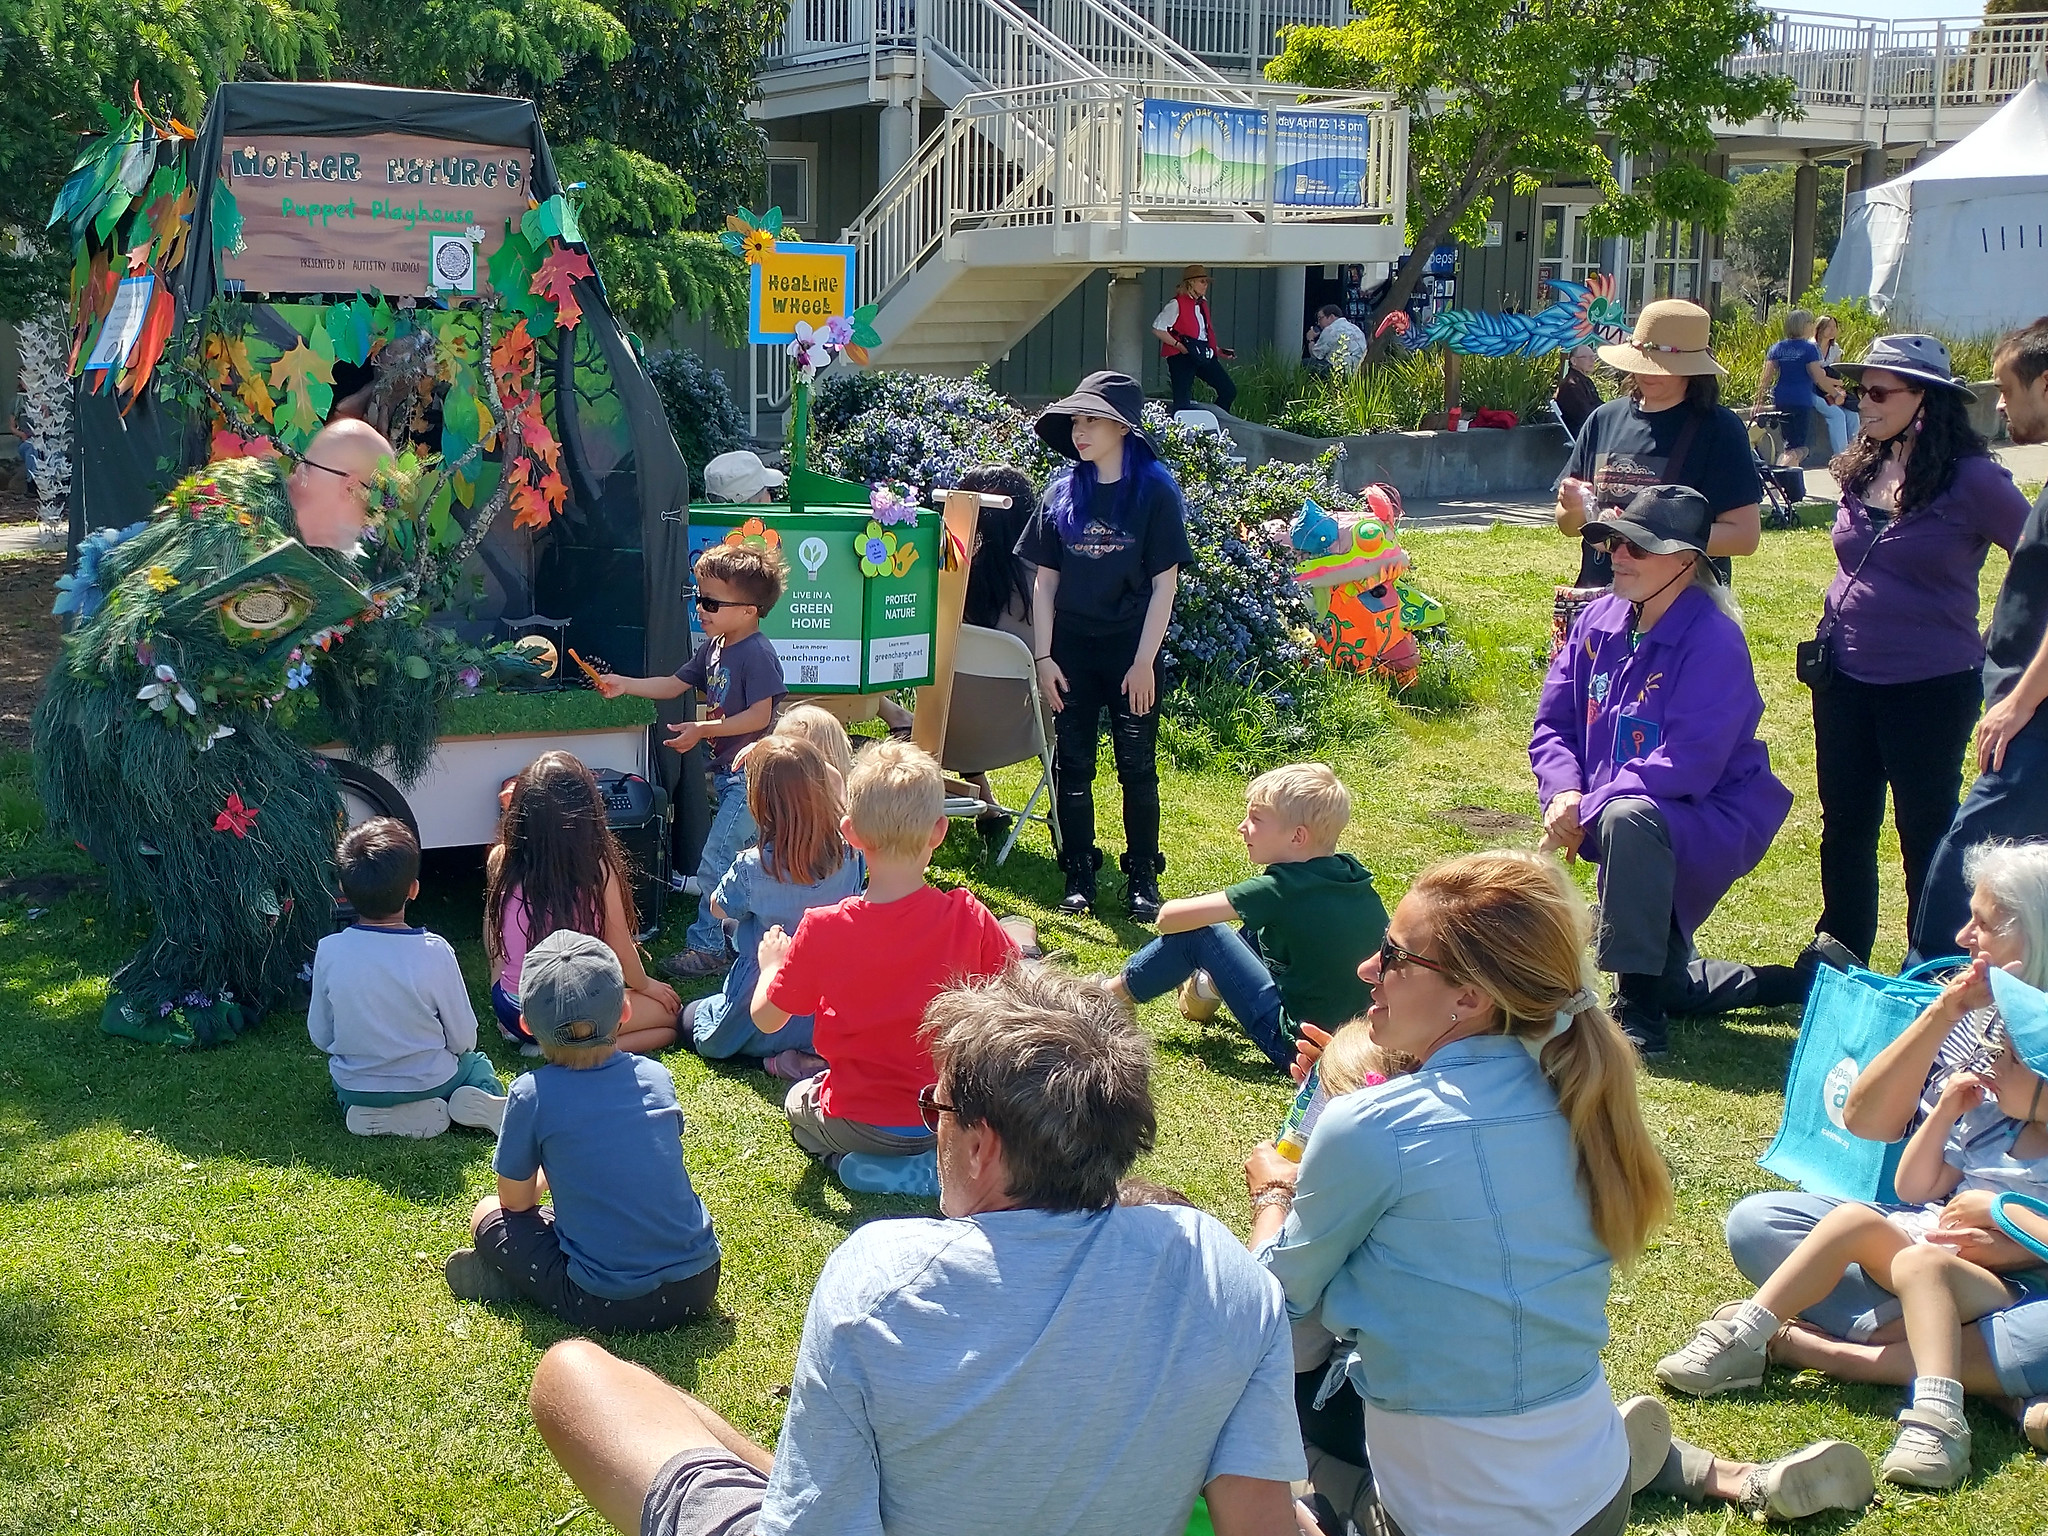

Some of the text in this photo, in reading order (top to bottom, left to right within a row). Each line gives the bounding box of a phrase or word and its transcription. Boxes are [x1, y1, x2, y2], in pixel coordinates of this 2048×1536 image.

[1195, 108, 1213, 118] DAY
[1296, 117, 1318, 130] April
[1319, 118, 1330, 129] 23
[1334, 119, 1346, 130] 1-5
[1348, 122, 1363, 132] pm
[281, 197, 475, 231] Puppet Playhouse
[300, 258, 336, 270] PRESENTED
[337, 258, 346, 270] BY
[352, 260, 387, 271] AUTISTRY
[792, 591, 832, 599] LIVE IN A
[885, 593, 917, 606] PROTECT
[789, 603, 833, 614] GREEN
[885, 607, 916, 620] NATURE
[791, 618, 831, 629] HOME
[777, 653, 851, 664] reenchange.net
